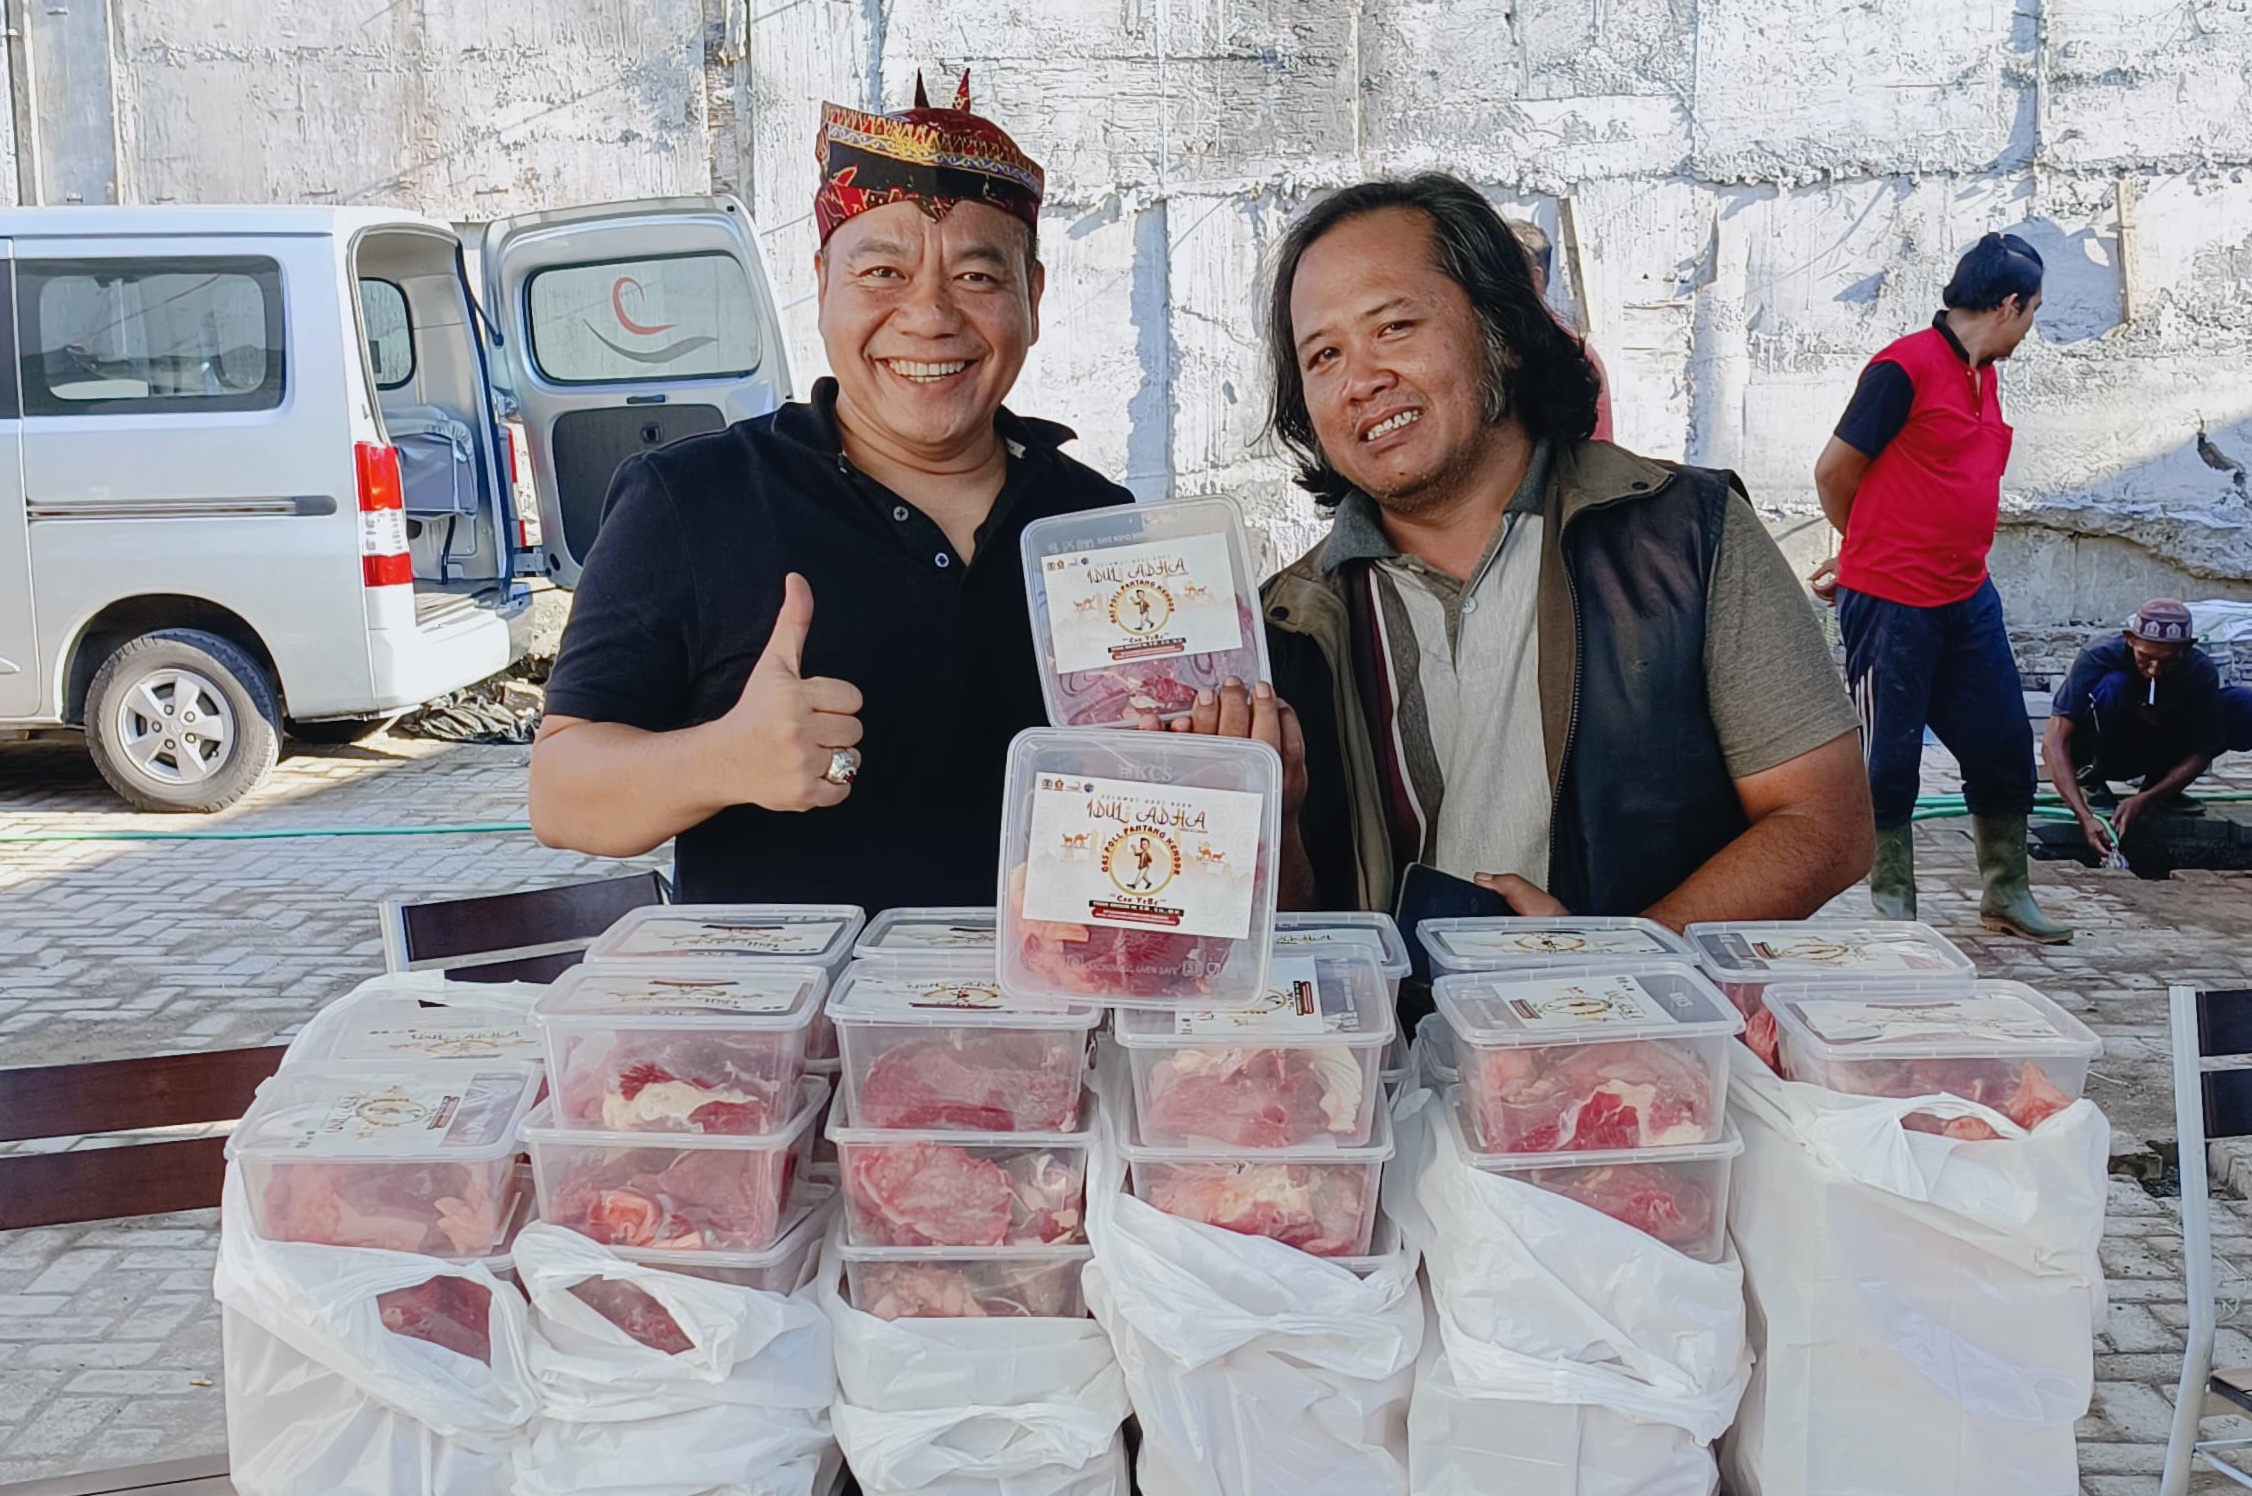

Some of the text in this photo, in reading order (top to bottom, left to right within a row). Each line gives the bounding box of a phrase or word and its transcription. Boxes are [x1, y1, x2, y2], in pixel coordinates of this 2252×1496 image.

[1087, 567, 1123, 584] IDUL
[1127, 558, 1186, 578] ADHA
[1087, 800, 1128, 824] IDUL
[1136, 806, 1206, 829] ADHA
[1101, 825, 1182, 875] GAS POLL PANTANG KENDOR
